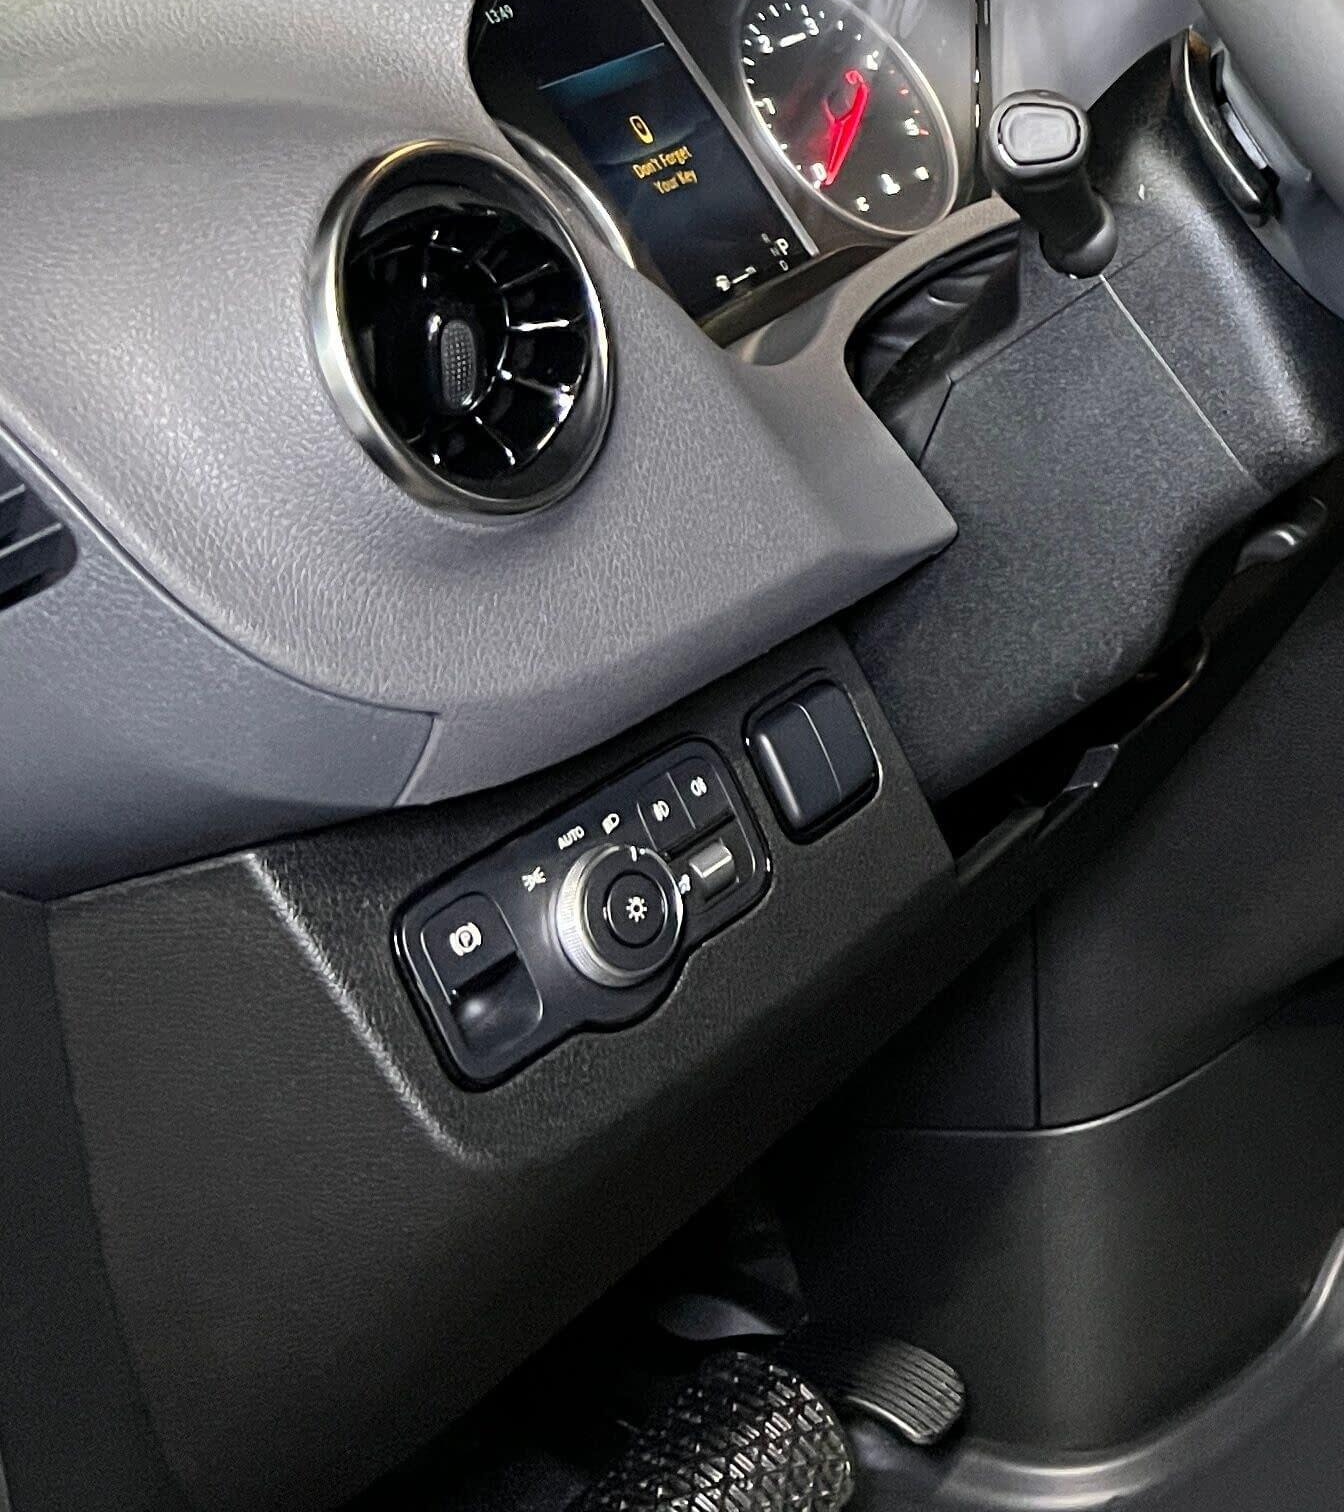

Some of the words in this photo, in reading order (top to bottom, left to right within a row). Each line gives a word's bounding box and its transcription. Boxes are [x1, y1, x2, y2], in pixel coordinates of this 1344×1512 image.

[804, 17, 820, 35] 3
[757, 35, 774, 54] 2
[775, 238, 789, 256] P
[557, 825, 585, 850] AUTO
